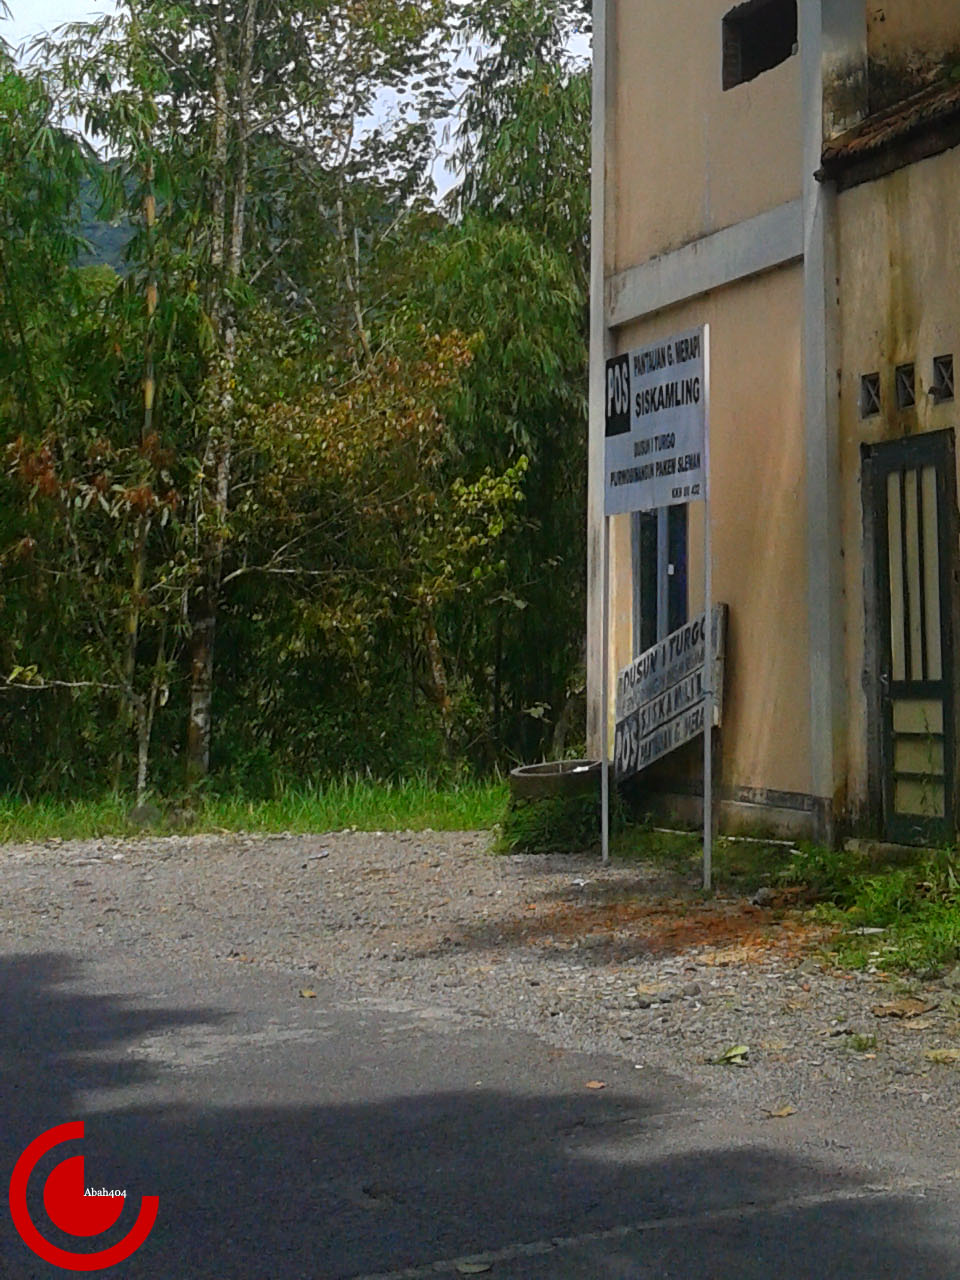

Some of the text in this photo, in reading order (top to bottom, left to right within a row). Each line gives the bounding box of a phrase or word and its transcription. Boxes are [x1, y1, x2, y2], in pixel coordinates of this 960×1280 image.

[675, 335, 700, 363] MERAPI
[607, 362, 629, 417] POS
[635, 377, 700, 418] SISKAMLING
[623, 650, 658, 694] DUSUN
[615, 720, 639, 773] POS
